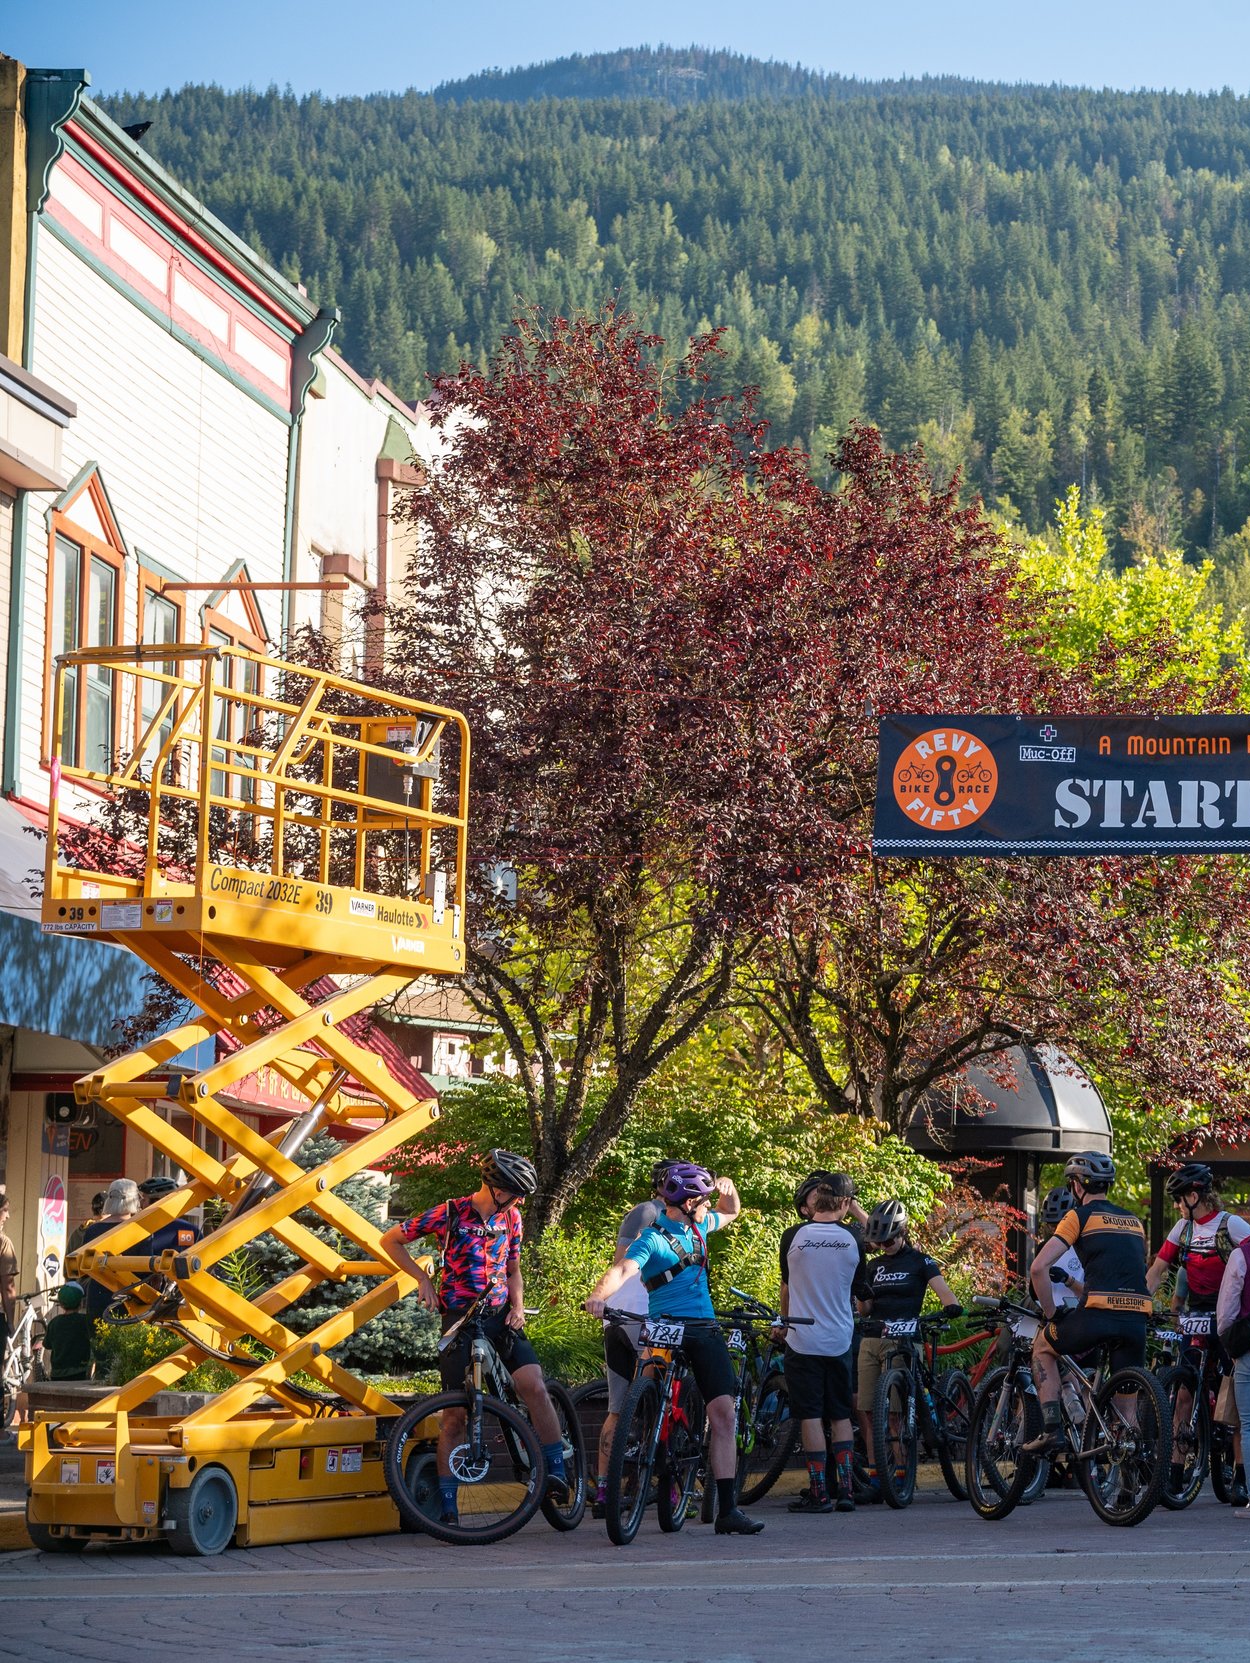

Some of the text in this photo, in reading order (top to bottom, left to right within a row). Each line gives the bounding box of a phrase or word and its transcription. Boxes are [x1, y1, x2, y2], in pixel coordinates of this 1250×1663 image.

[915, 733, 982, 760] REVY
[1099, 736, 1111, 755] A
[1127, 735, 1231, 755] MOUNTAIN
[1021, 747, 1075, 762] Muc-Off
[900, 785, 930, 793] BIKE
[958, 785, 990, 794] RACE
[906, 797, 979, 826] FIFTY
[210, 867, 303, 905] Compact 2032E
[315, 889, 333, 915] 39
[69, 907, 84, 921] 39
[378, 905, 414, 927] Haulotte
[64, 923, 95, 931] CAPACITY
[1102, 1215, 1141, 1229] SKOOKUM
[180, 1234, 191, 1242] 50
[651, 1324, 680, 1343] 124
[890, 1321, 915, 1333] 031
[1185, 1320, 1209, 1334] 078
